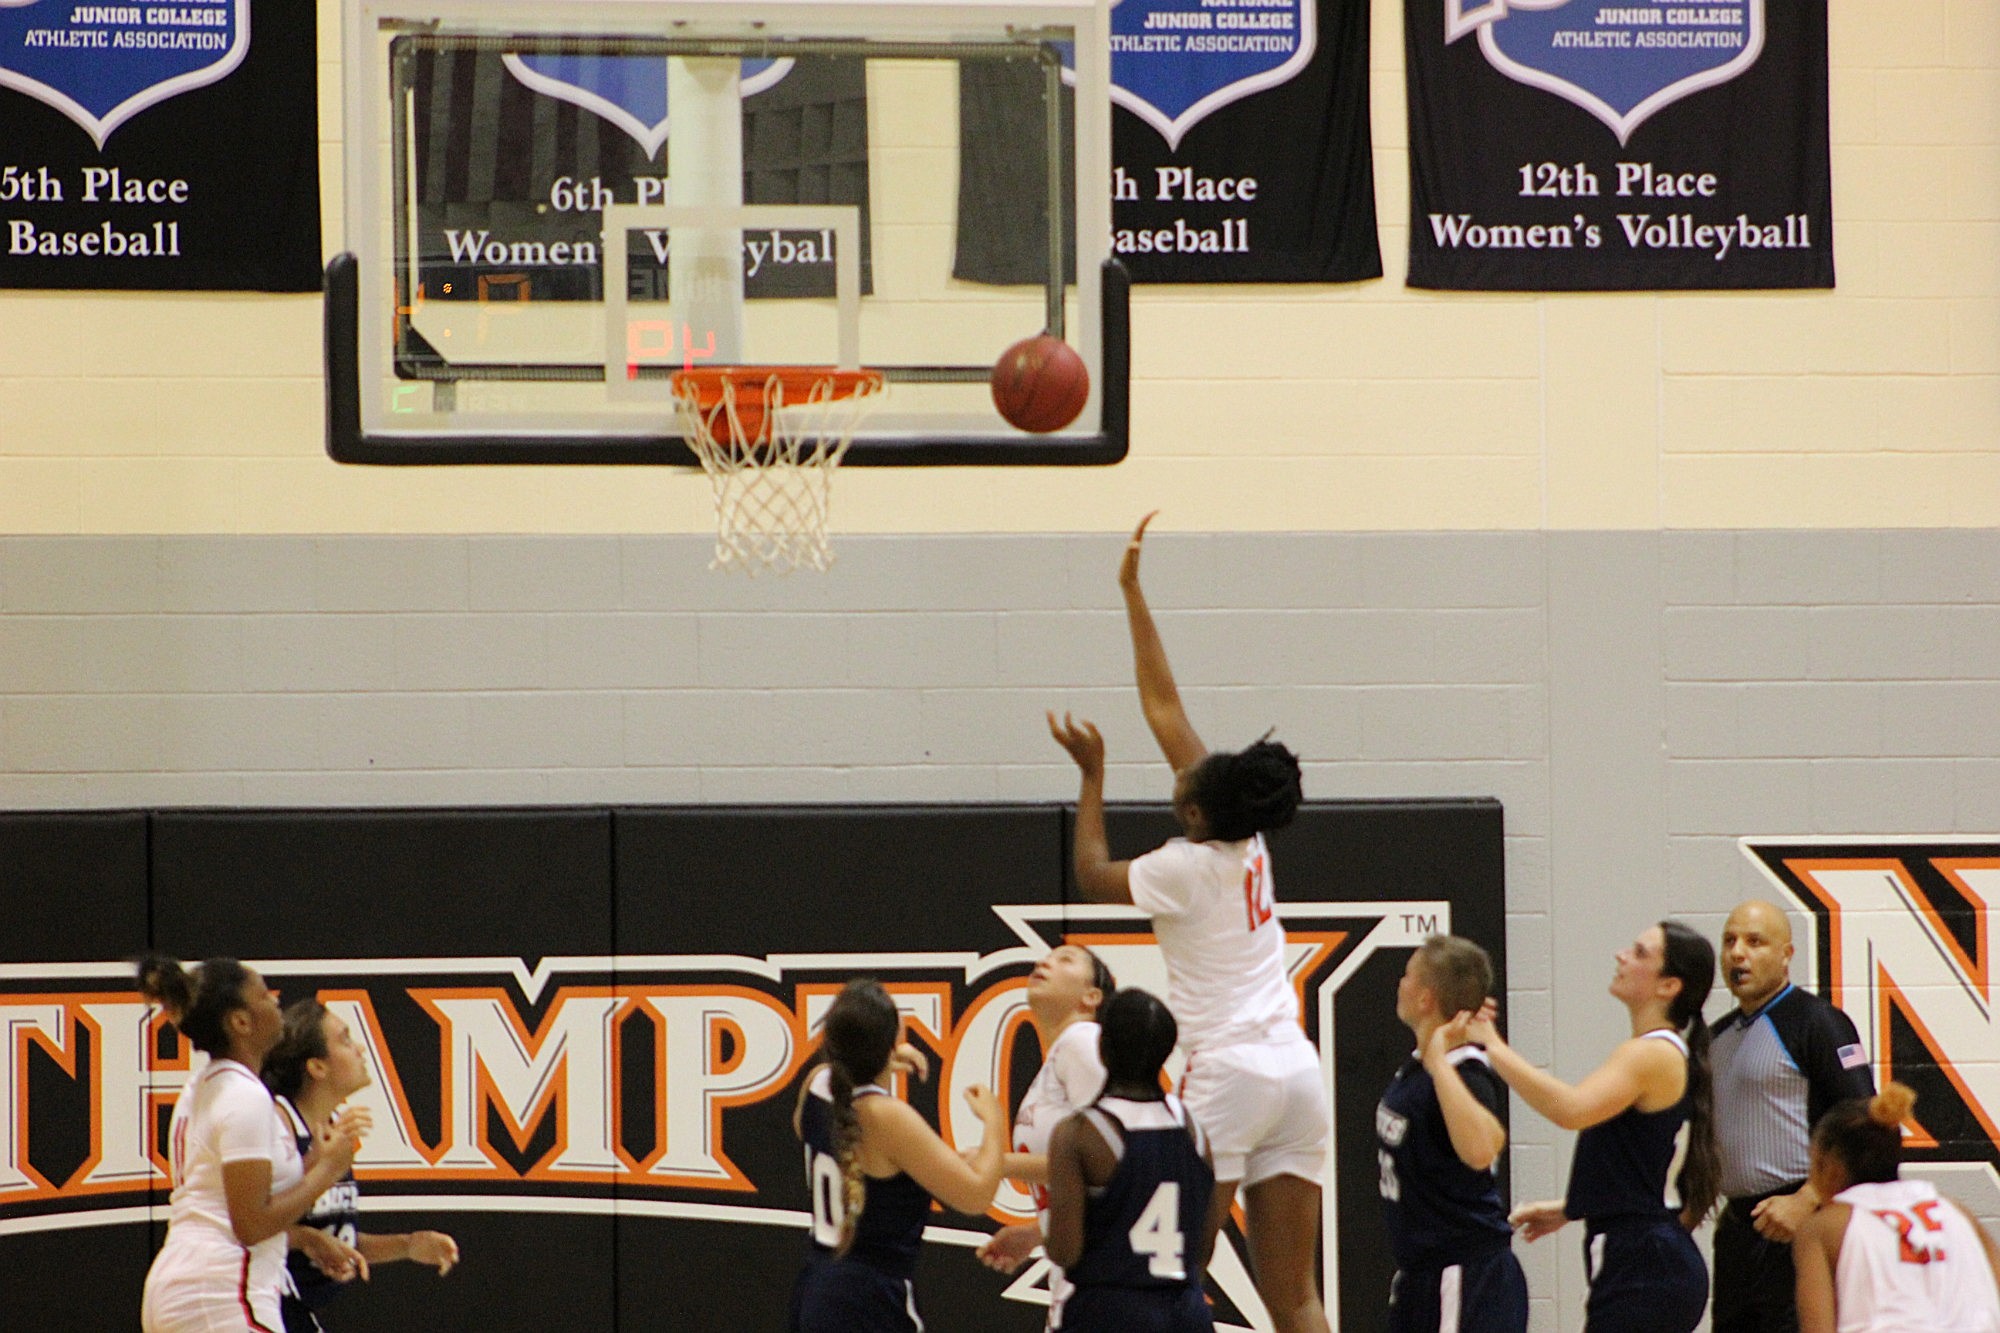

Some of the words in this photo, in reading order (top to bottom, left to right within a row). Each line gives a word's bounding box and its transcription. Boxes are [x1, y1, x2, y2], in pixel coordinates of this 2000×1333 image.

[70, 7, 141, 24] JUNIOR
[146, 9, 227, 26] COLLEGE
[1144, 12, 1212, 29] JUNIOR
[1216, 13, 1293, 29] COLLEGE
[1595, 9, 1662, 25] JUNIOR
[1666, 9, 1742, 25] COLLEGE
[24, 30, 108, 47] ATHLETIC
[112, 32, 227, 49] ASSOCIATION
[1185, 36, 1293, 52] ASSOCIATION
[1552, 31, 1631, 48] ATHLETIC
[1635, 32, 1742, 48] ASSOCIATION
[0, 166, 63, 201] 5th
[81, 167, 189, 203] Place
[551, 176, 614, 211] 6th
[1155, 167, 1258, 201] Place
[1519, 163, 1600, 198] 12th
[1615, 163, 1717, 197] Place
[8, 220, 180, 256] Baseball
[444, 229, 607, 265] Women
[1109, 219, 1249, 253] aseball
[1428, 214, 1601, 248] Women's
[1617, 214, 1811, 261] Volleyball
[1244, 855, 1273, 932] 12
[1402, 914, 1438, 933] TM
[1128, 1182, 1186, 1280] 4
